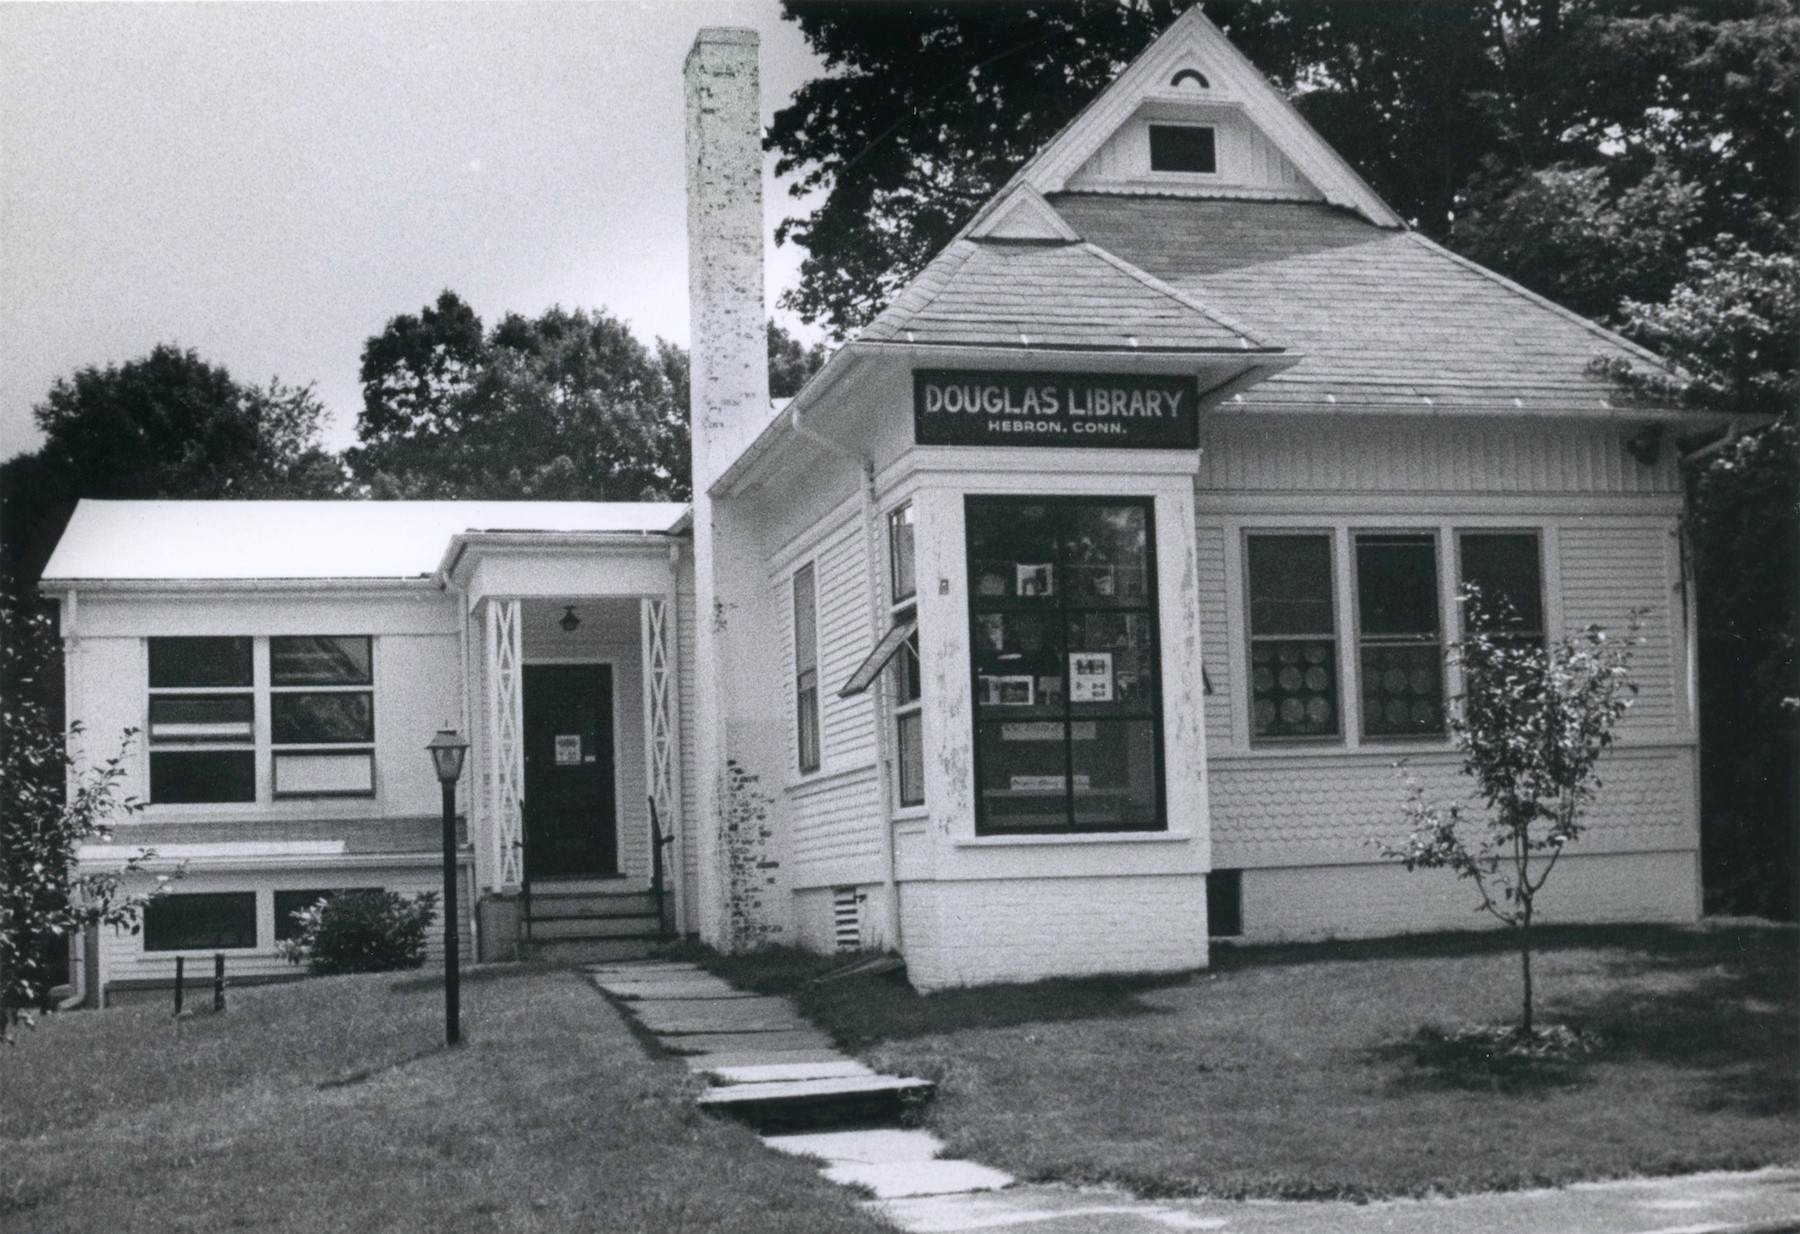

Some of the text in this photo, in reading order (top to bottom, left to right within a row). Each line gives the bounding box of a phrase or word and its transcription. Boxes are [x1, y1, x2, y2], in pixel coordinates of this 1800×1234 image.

[926, 384, 1184, 417] DOUGLAS LIBRARY
[1072, 421, 1127, 434] CONN.
